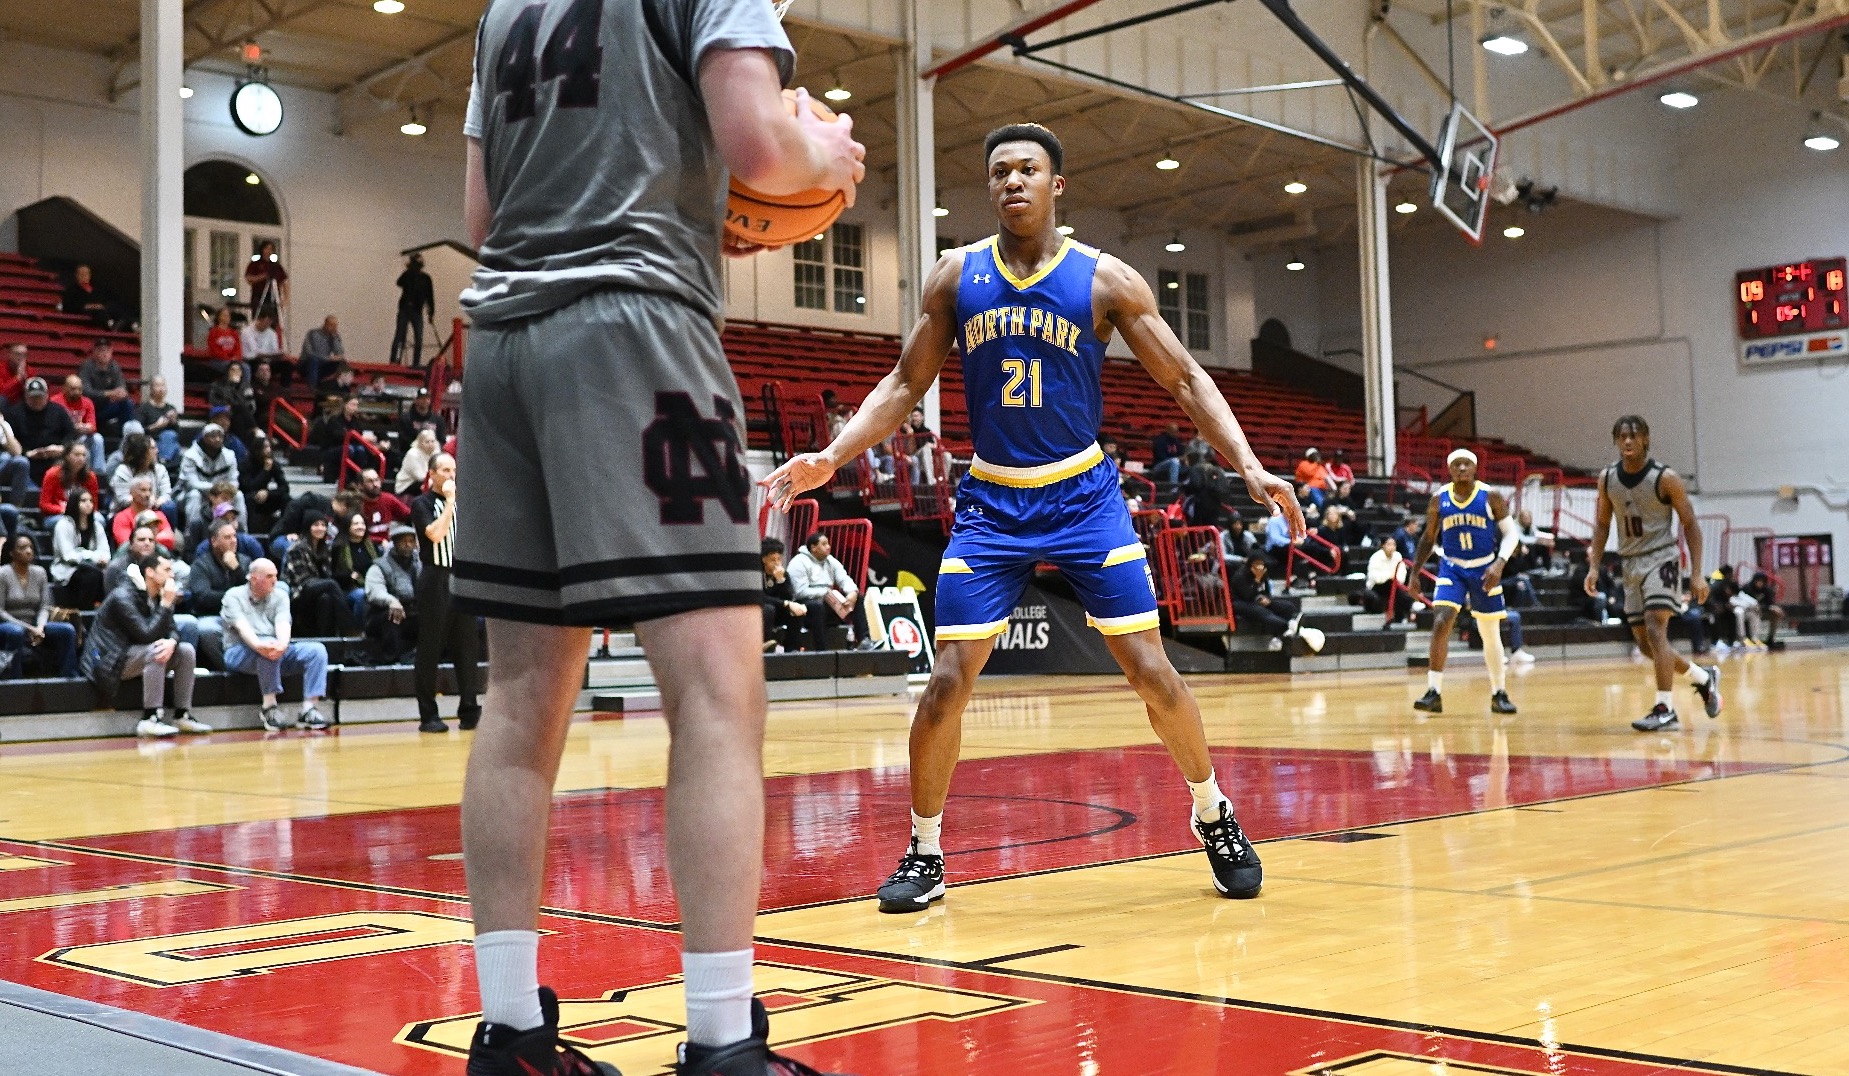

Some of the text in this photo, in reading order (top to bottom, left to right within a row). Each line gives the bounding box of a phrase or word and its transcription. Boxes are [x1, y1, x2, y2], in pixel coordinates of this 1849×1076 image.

[496, 0, 603, 123] 44
[1741, 281, 1764, 302] 09
[964, 306, 1081, 357] NORTH PARK
[1001, 359, 1042, 408] 21
[1459, 532, 1473, 551] 11
[1624, 515, 1643, 537] 10
